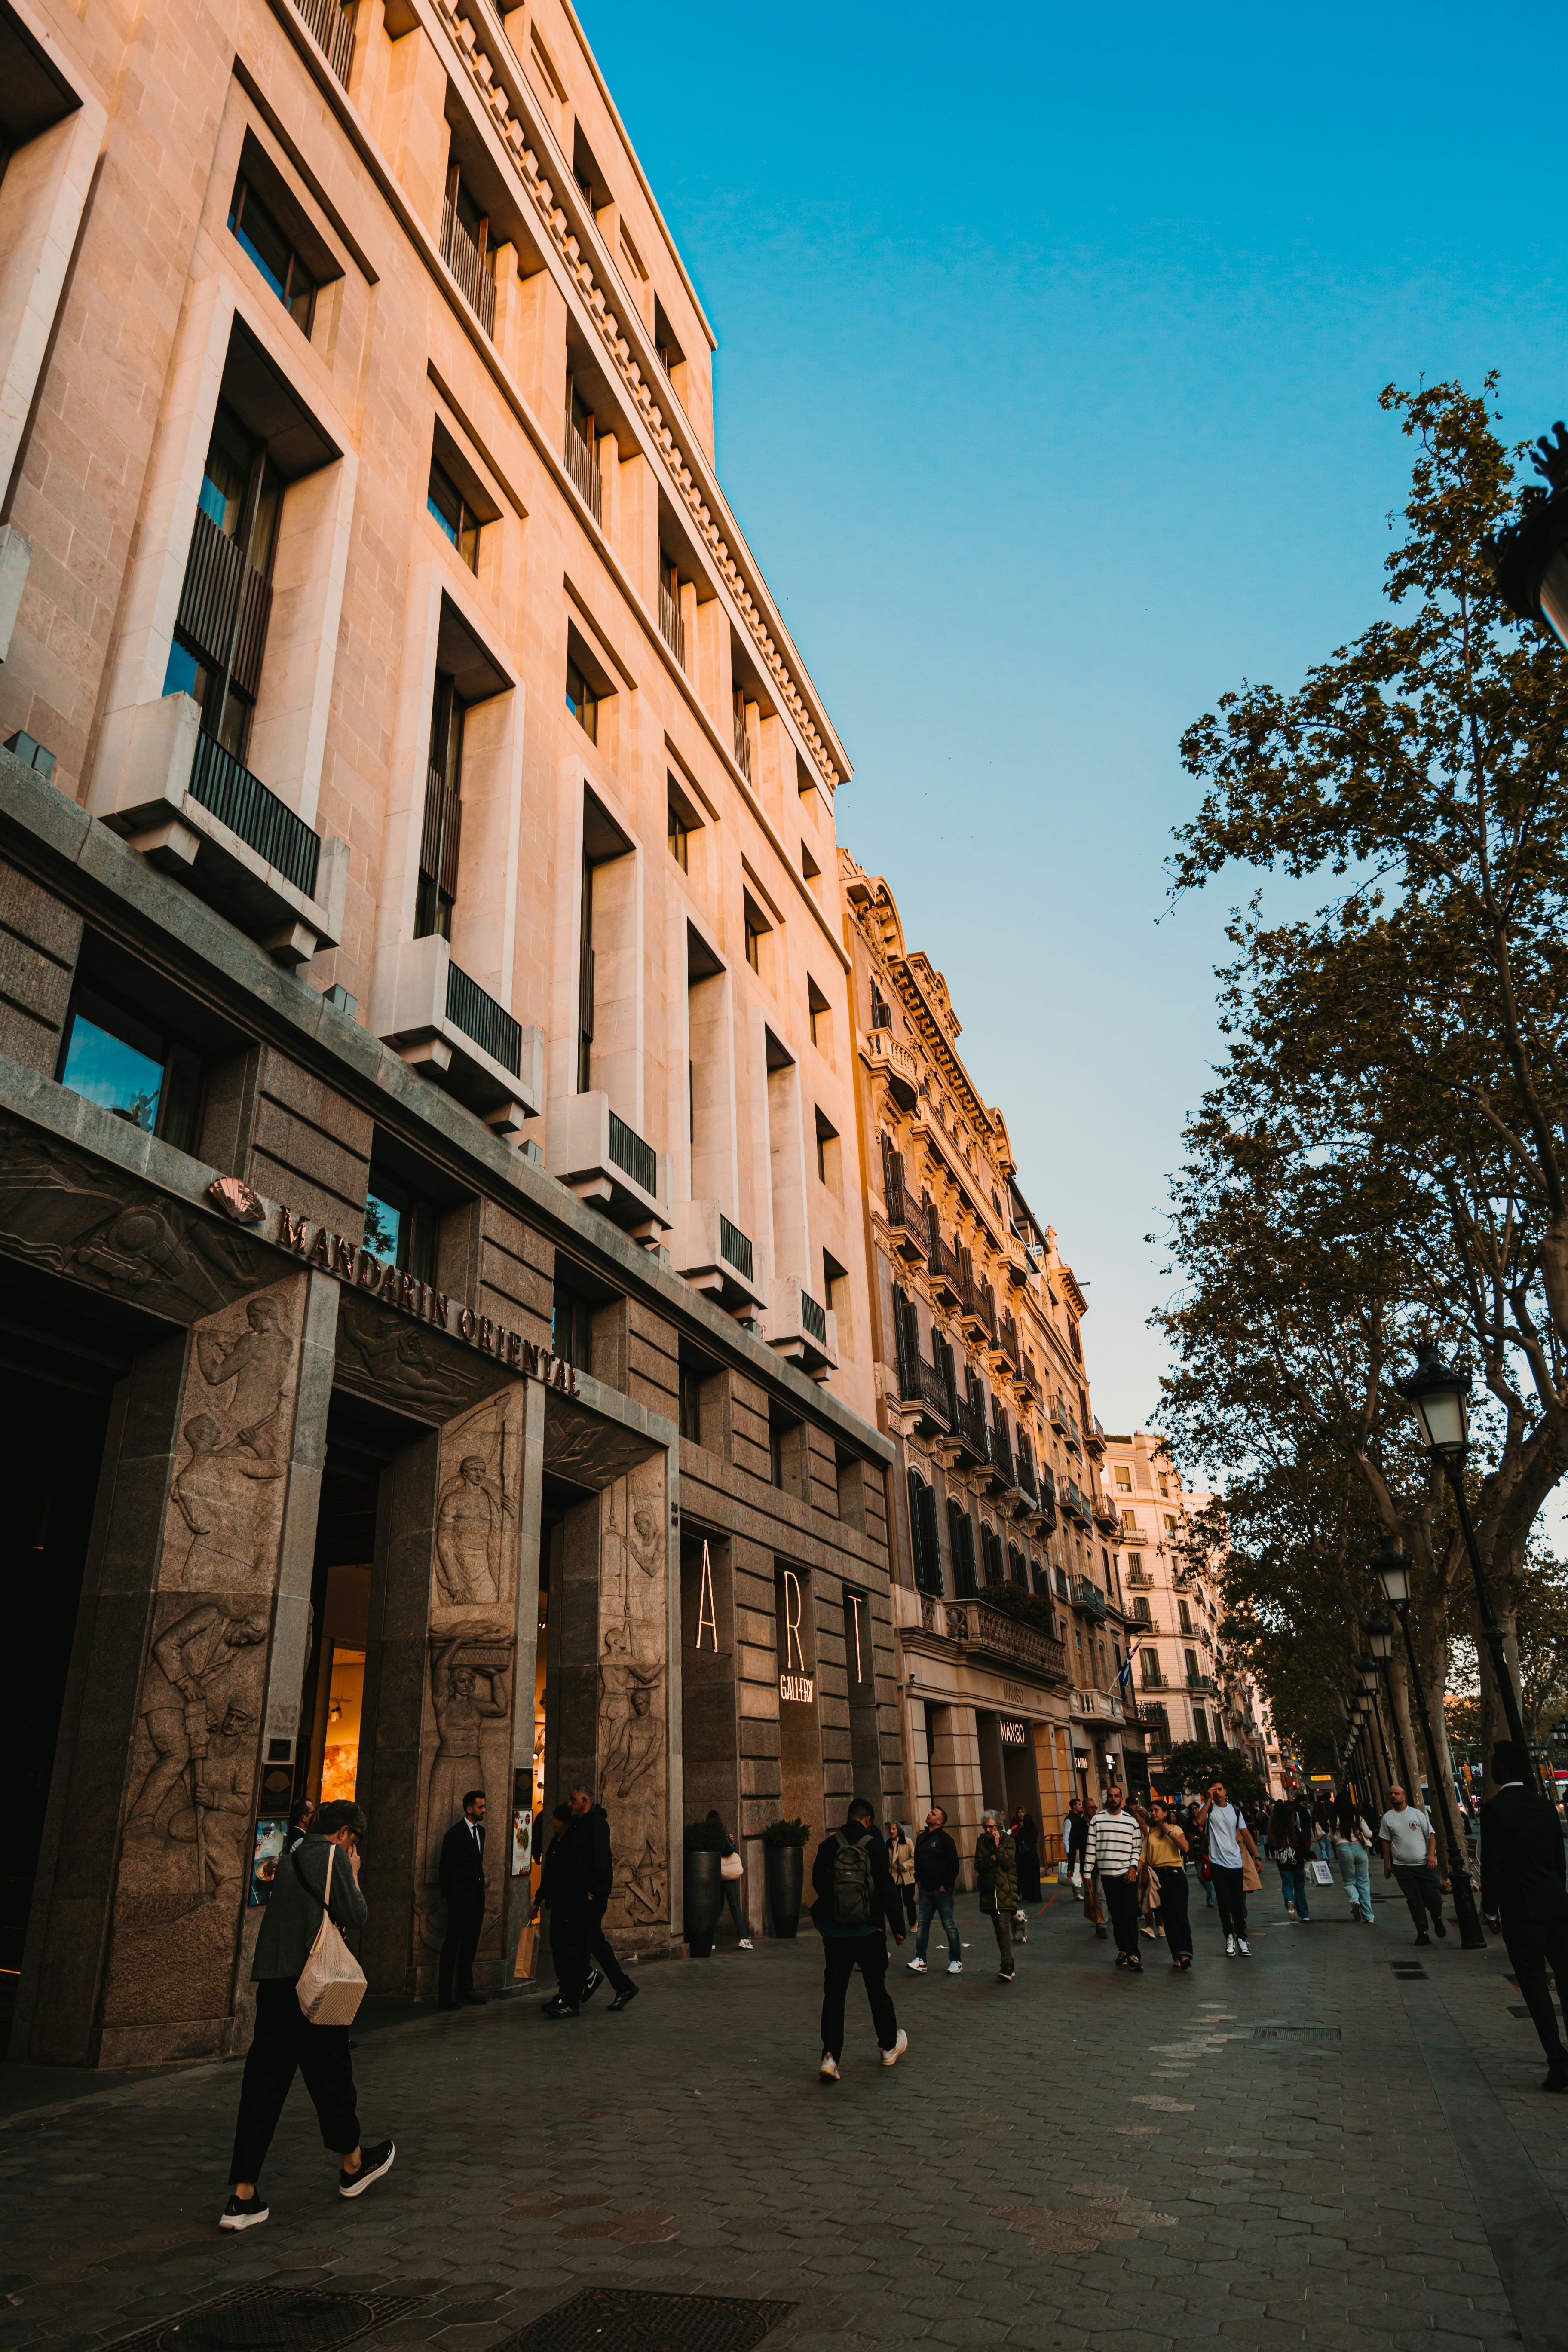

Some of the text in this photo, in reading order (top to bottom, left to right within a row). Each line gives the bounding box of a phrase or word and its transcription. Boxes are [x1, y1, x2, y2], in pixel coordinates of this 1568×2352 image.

[276, 1205, 580, 1396] MANDARIN ORIENTAL
[696, 1539, 862, 1683] ART
[780, 1674, 813, 1703] GALLERY
[1003, 1682, 1024, 1704] MANGO
[1000, 1720, 1025, 1744] MANGO
[364, 2163, 378, 2174] HOKA
